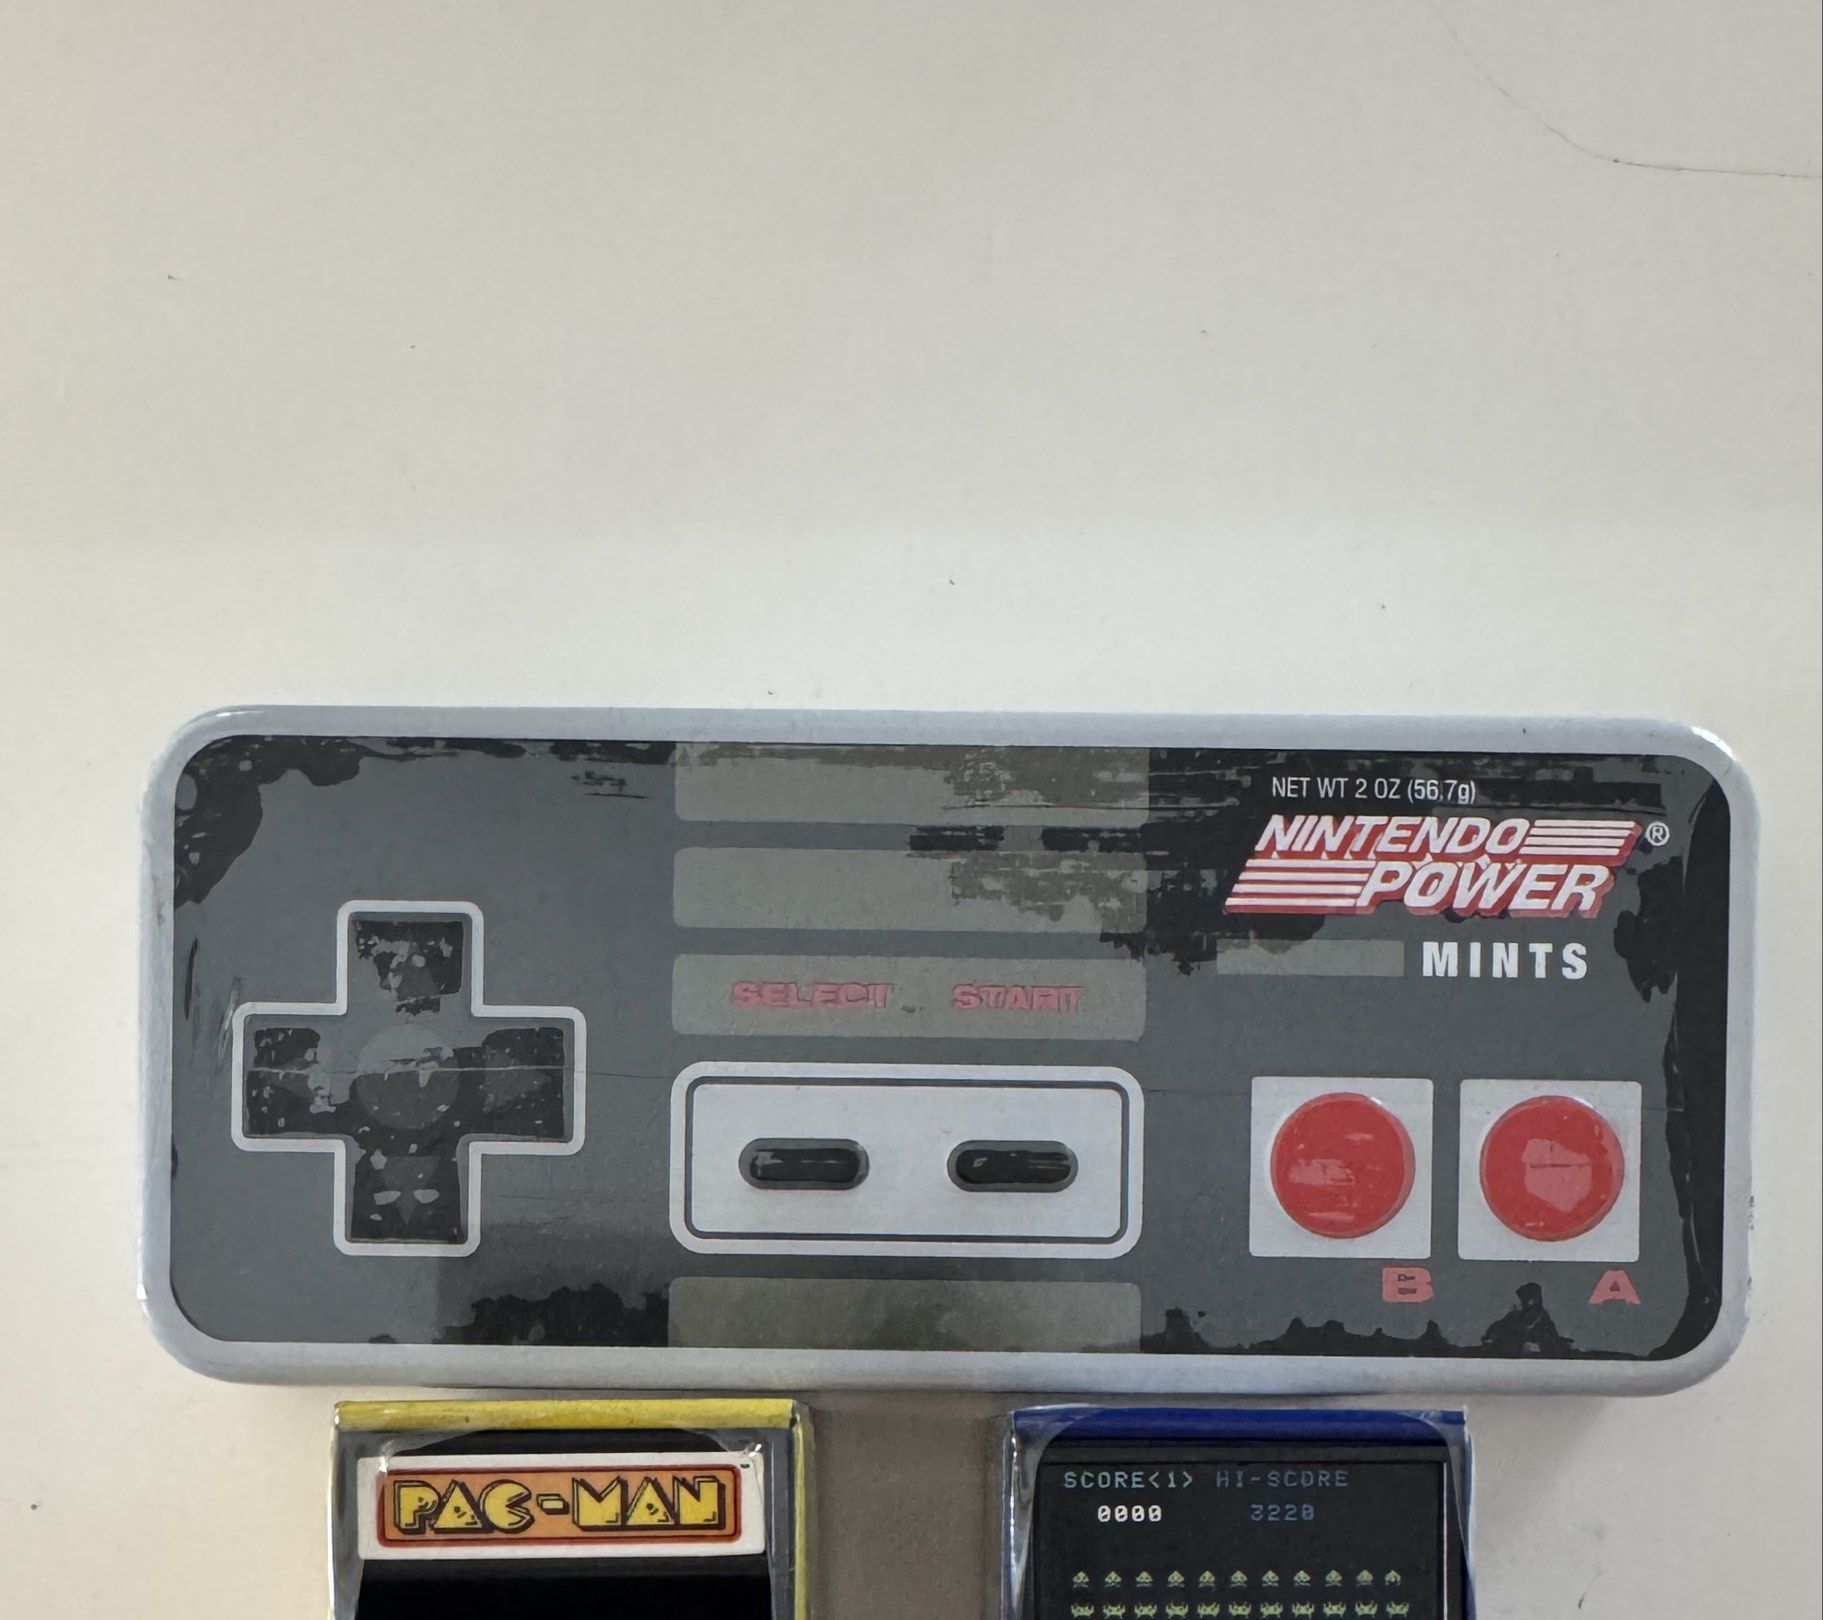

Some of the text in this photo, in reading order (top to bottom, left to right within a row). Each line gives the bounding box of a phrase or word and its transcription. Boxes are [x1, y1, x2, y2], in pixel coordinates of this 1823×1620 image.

[1271, 776, 1477, 805] NET WT 2 OZ (56.7g)
[1254, 813, 1531, 856] NINTENDO
[1356, 861, 1614, 916] POWER
[1421, 941, 1588, 980] MINTS
[731, 981, 894, 1009] SELECT
[951, 983, 1085, 1012] START
[1381, 1265, 1435, 1303] B
[1587, 1268, 1642, 1306] A
[1063, 1469, 1350, 1490] SCORE<1> HI-SCORE
[393, 1474, 727, 1534] PAC-MAN
[1097, 1503, 1315, 1523] 0000 3220
